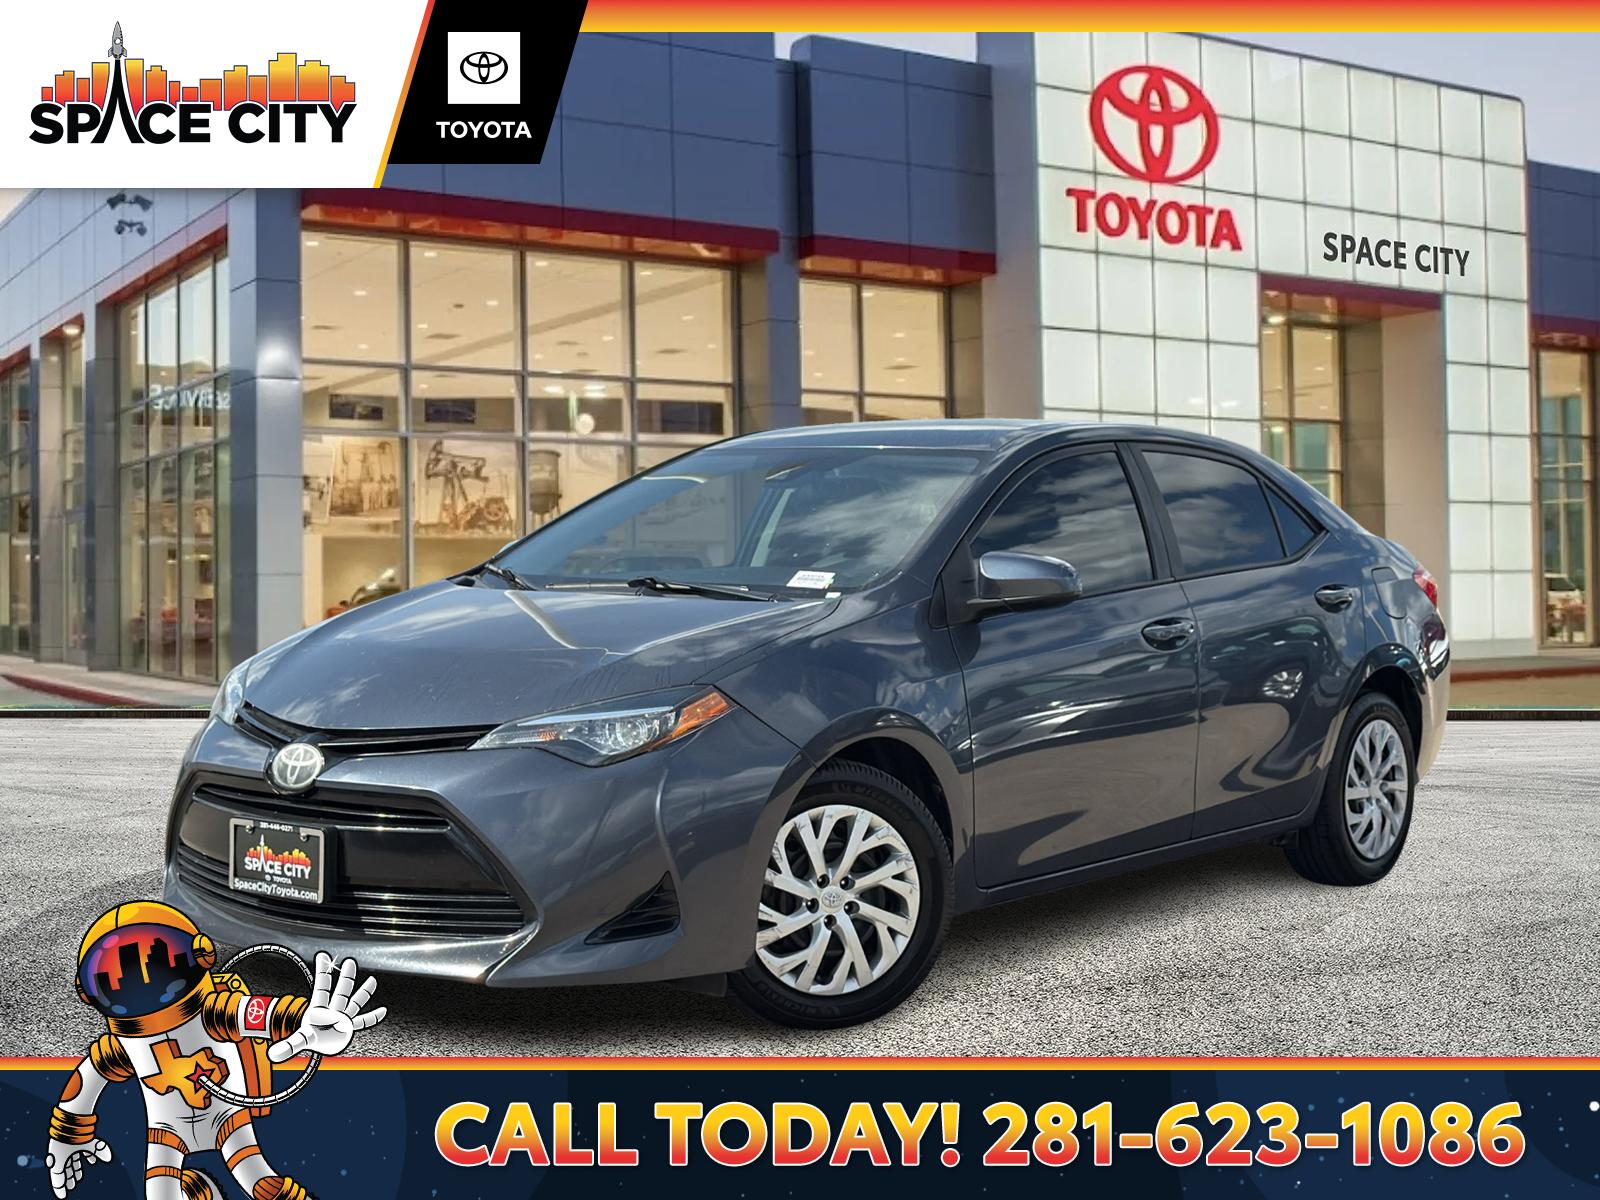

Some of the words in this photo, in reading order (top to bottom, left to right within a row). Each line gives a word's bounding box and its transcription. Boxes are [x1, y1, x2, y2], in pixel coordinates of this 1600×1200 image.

[1065, 187, 1243, 251] TOYOTA
[1322, 231, 1407, 270] SPACE
[1414, 243, 1471, 277] CITY
[244, 855, 282, 875] SPACE
[283, 862, 311, 879] CITY
[233, 877, 318, 901] SpaceCityToyota.com
